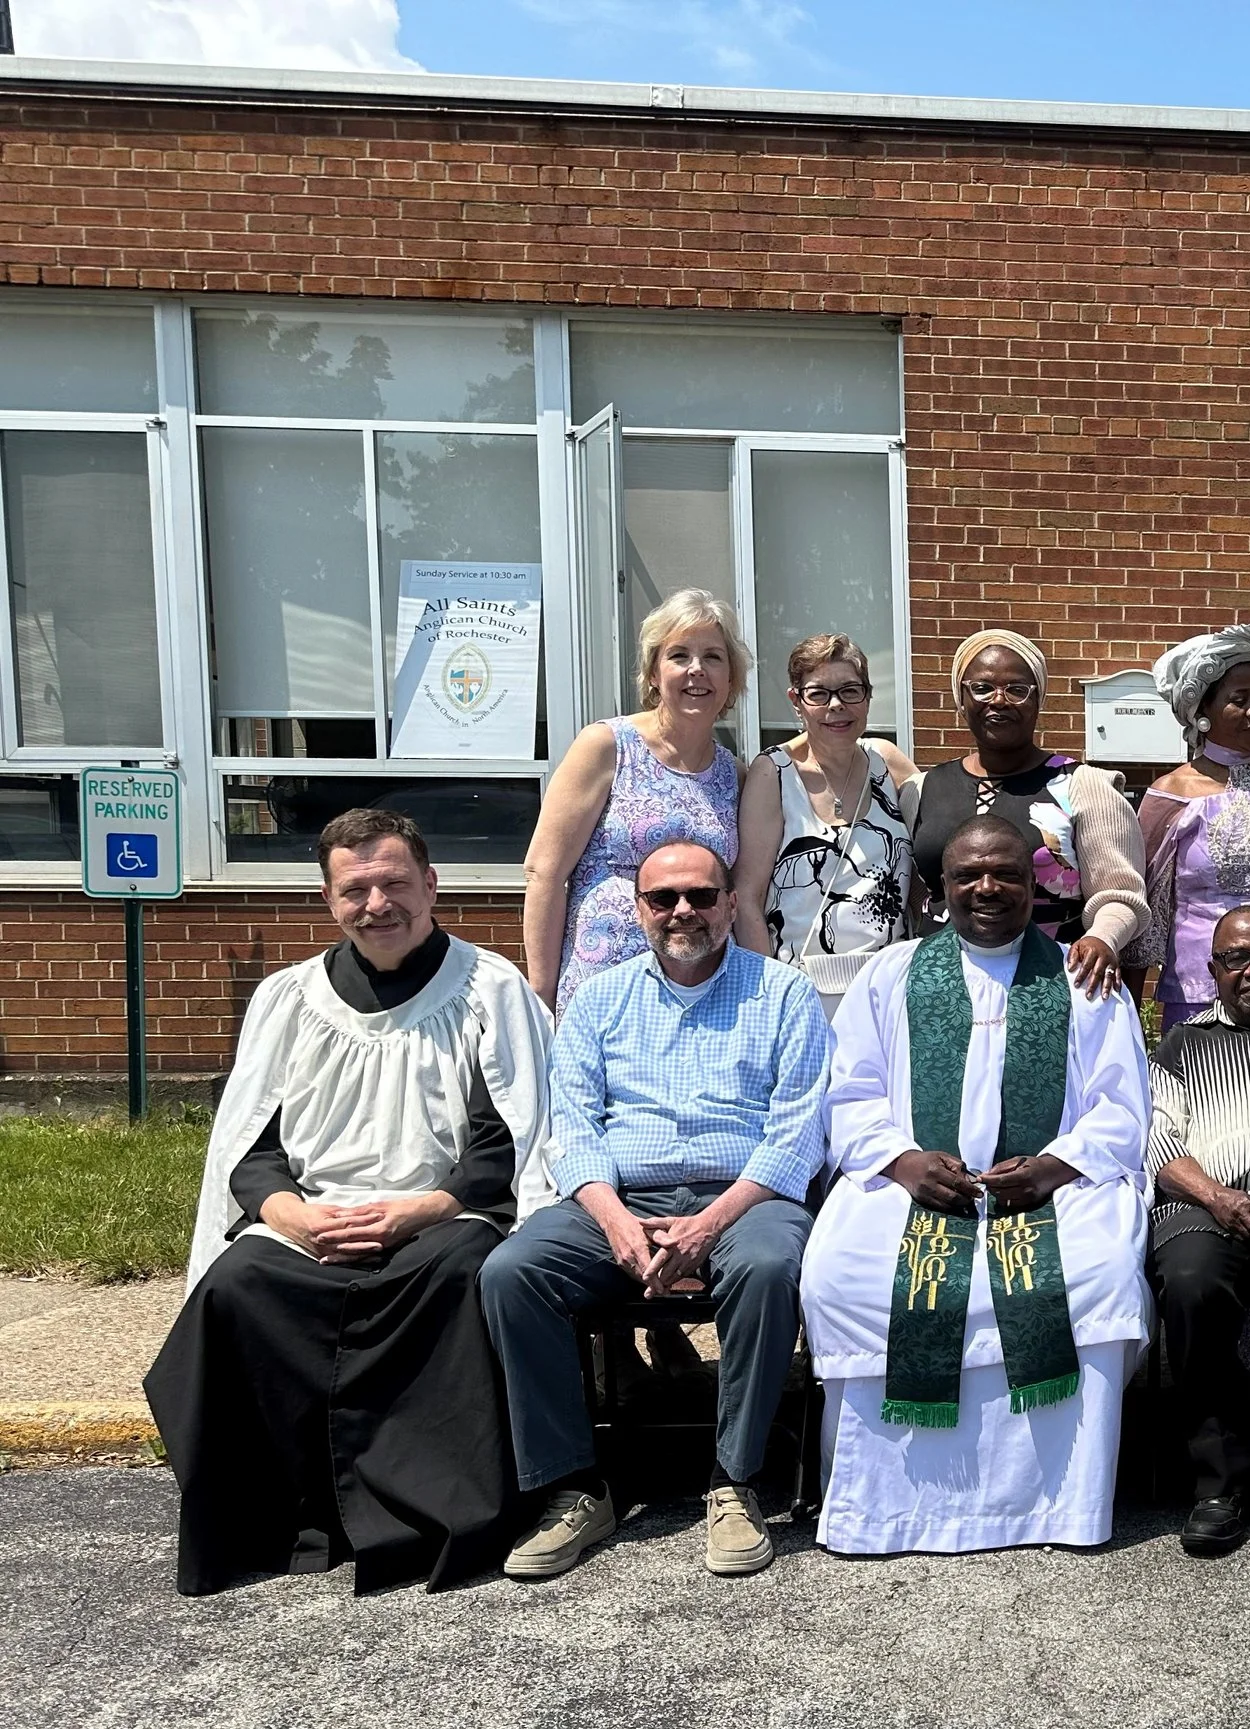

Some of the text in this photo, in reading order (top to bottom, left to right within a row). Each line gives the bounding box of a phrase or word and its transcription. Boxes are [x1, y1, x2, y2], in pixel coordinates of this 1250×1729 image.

[416, 569, 447, 579] Sunday
[448, 570, 478, 579] Service
[490, 571, 512, 579] 10:30
[423, 597, 517, 617] All Saints
[414, 615, 528, 637] Anglican Church
[427, 629, 513, 644] of Rochester
[423, 684, 441, 710] Anglican
[439, 707, 460, 726] Church
[472, 710, 490, 724] North
[489, 689, 509, 711] America
[88, 780, 174, 798] RESERVED
[95, 802, 168, 820] PARKING
